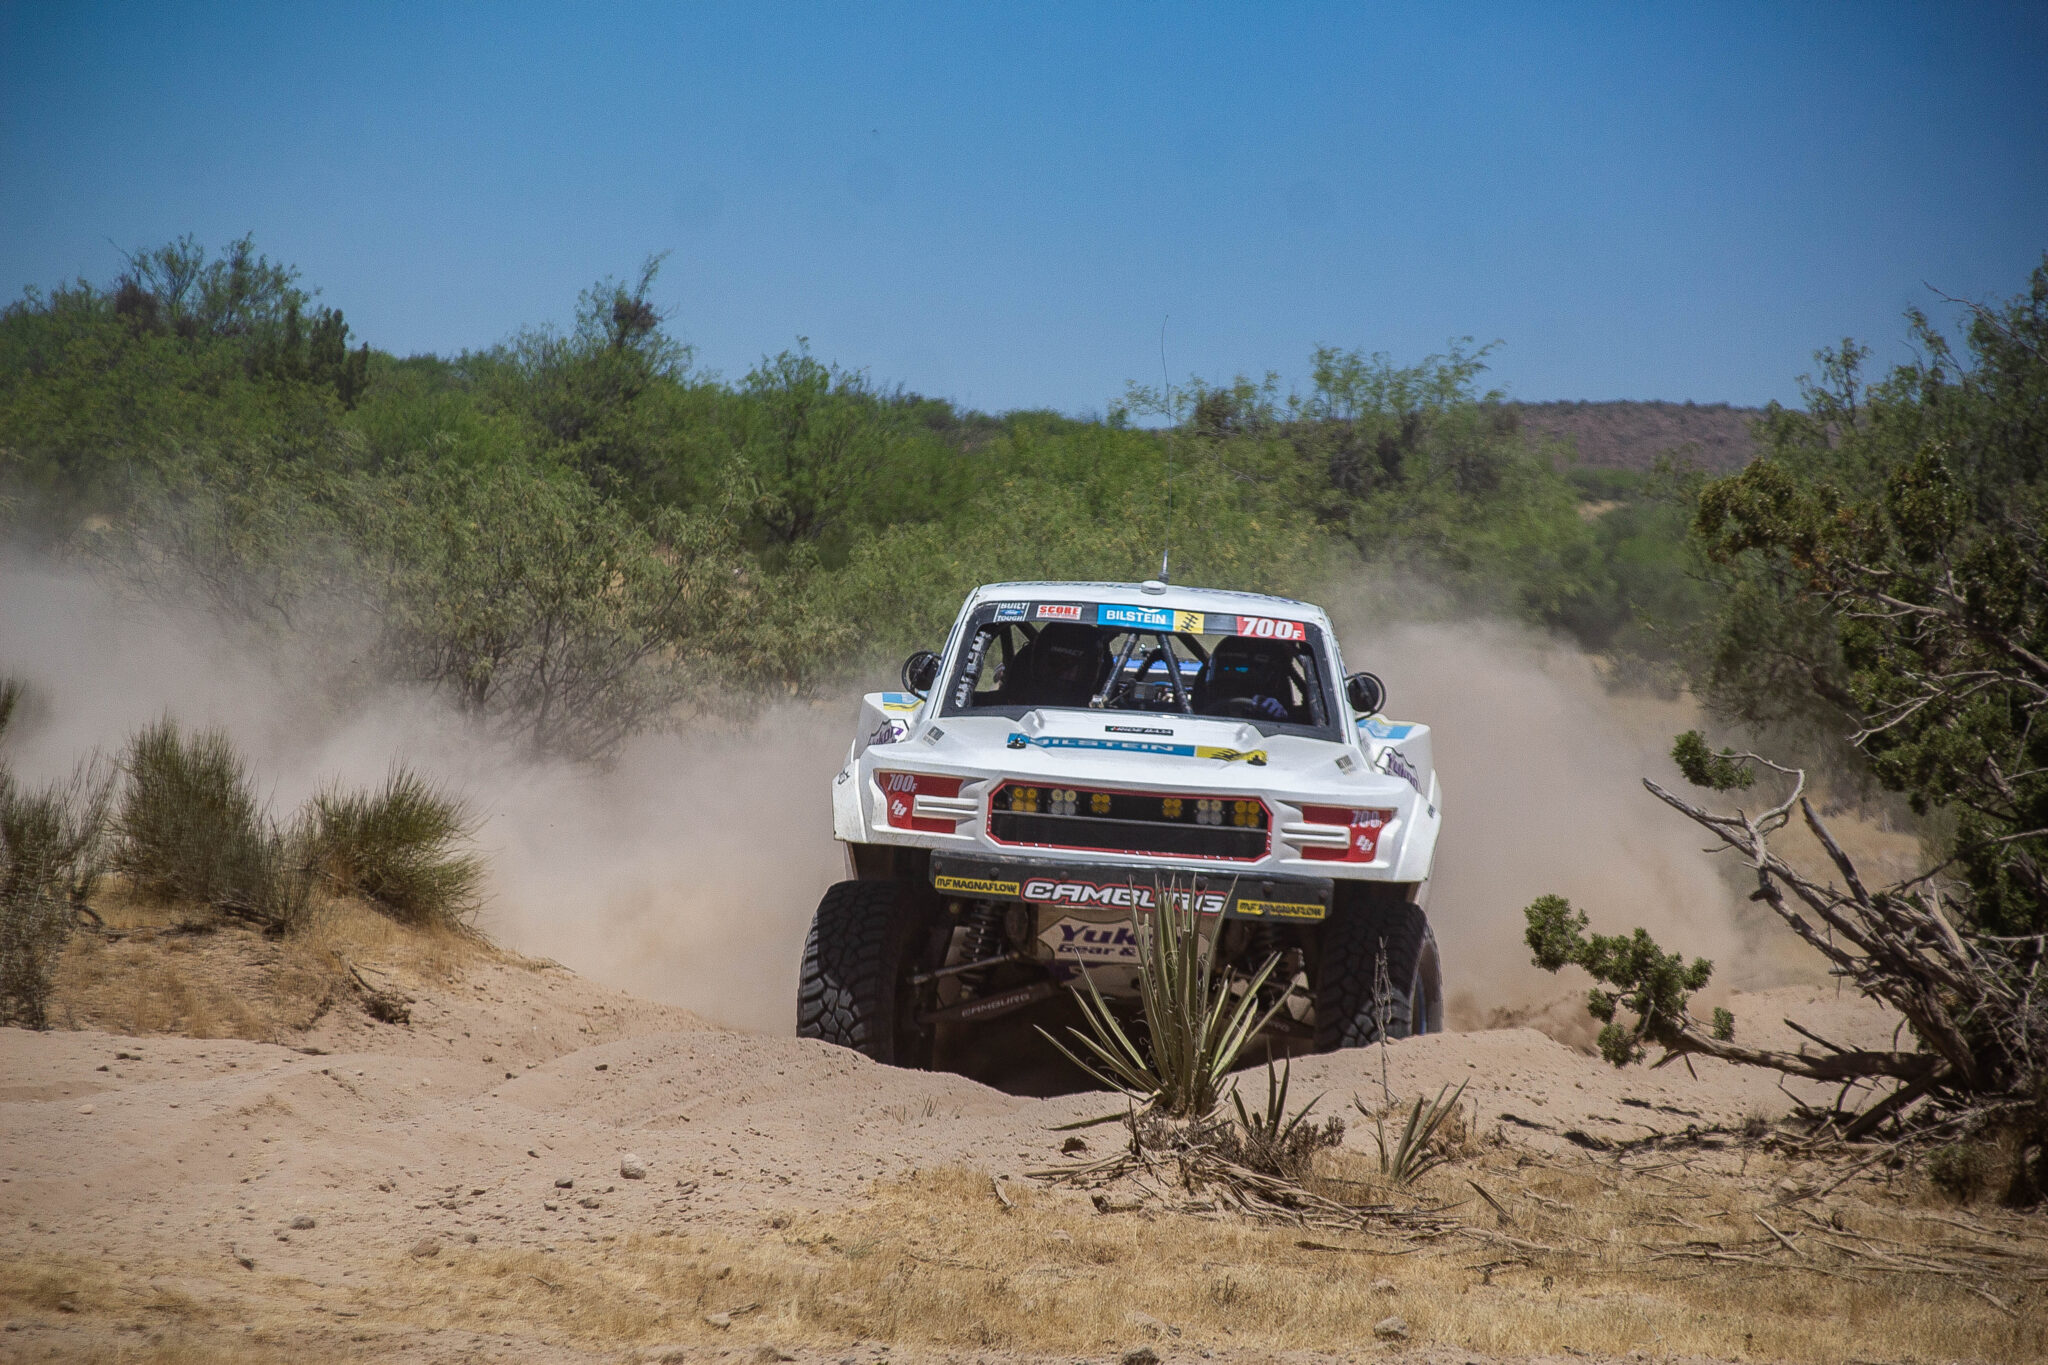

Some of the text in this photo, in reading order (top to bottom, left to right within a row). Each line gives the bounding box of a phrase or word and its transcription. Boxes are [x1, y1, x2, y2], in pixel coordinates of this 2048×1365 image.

[1039, 605, 1080, 615] SCORE
[1106, 609, 1167, 624] BILSTEIN
[1242, 617, 1302, 639] 700F
[887, 774, 917, 793] 700F
[952, 879, 1018, 894] MAGNAFLOW
[1060, 924, 1181, 946] Yuk
